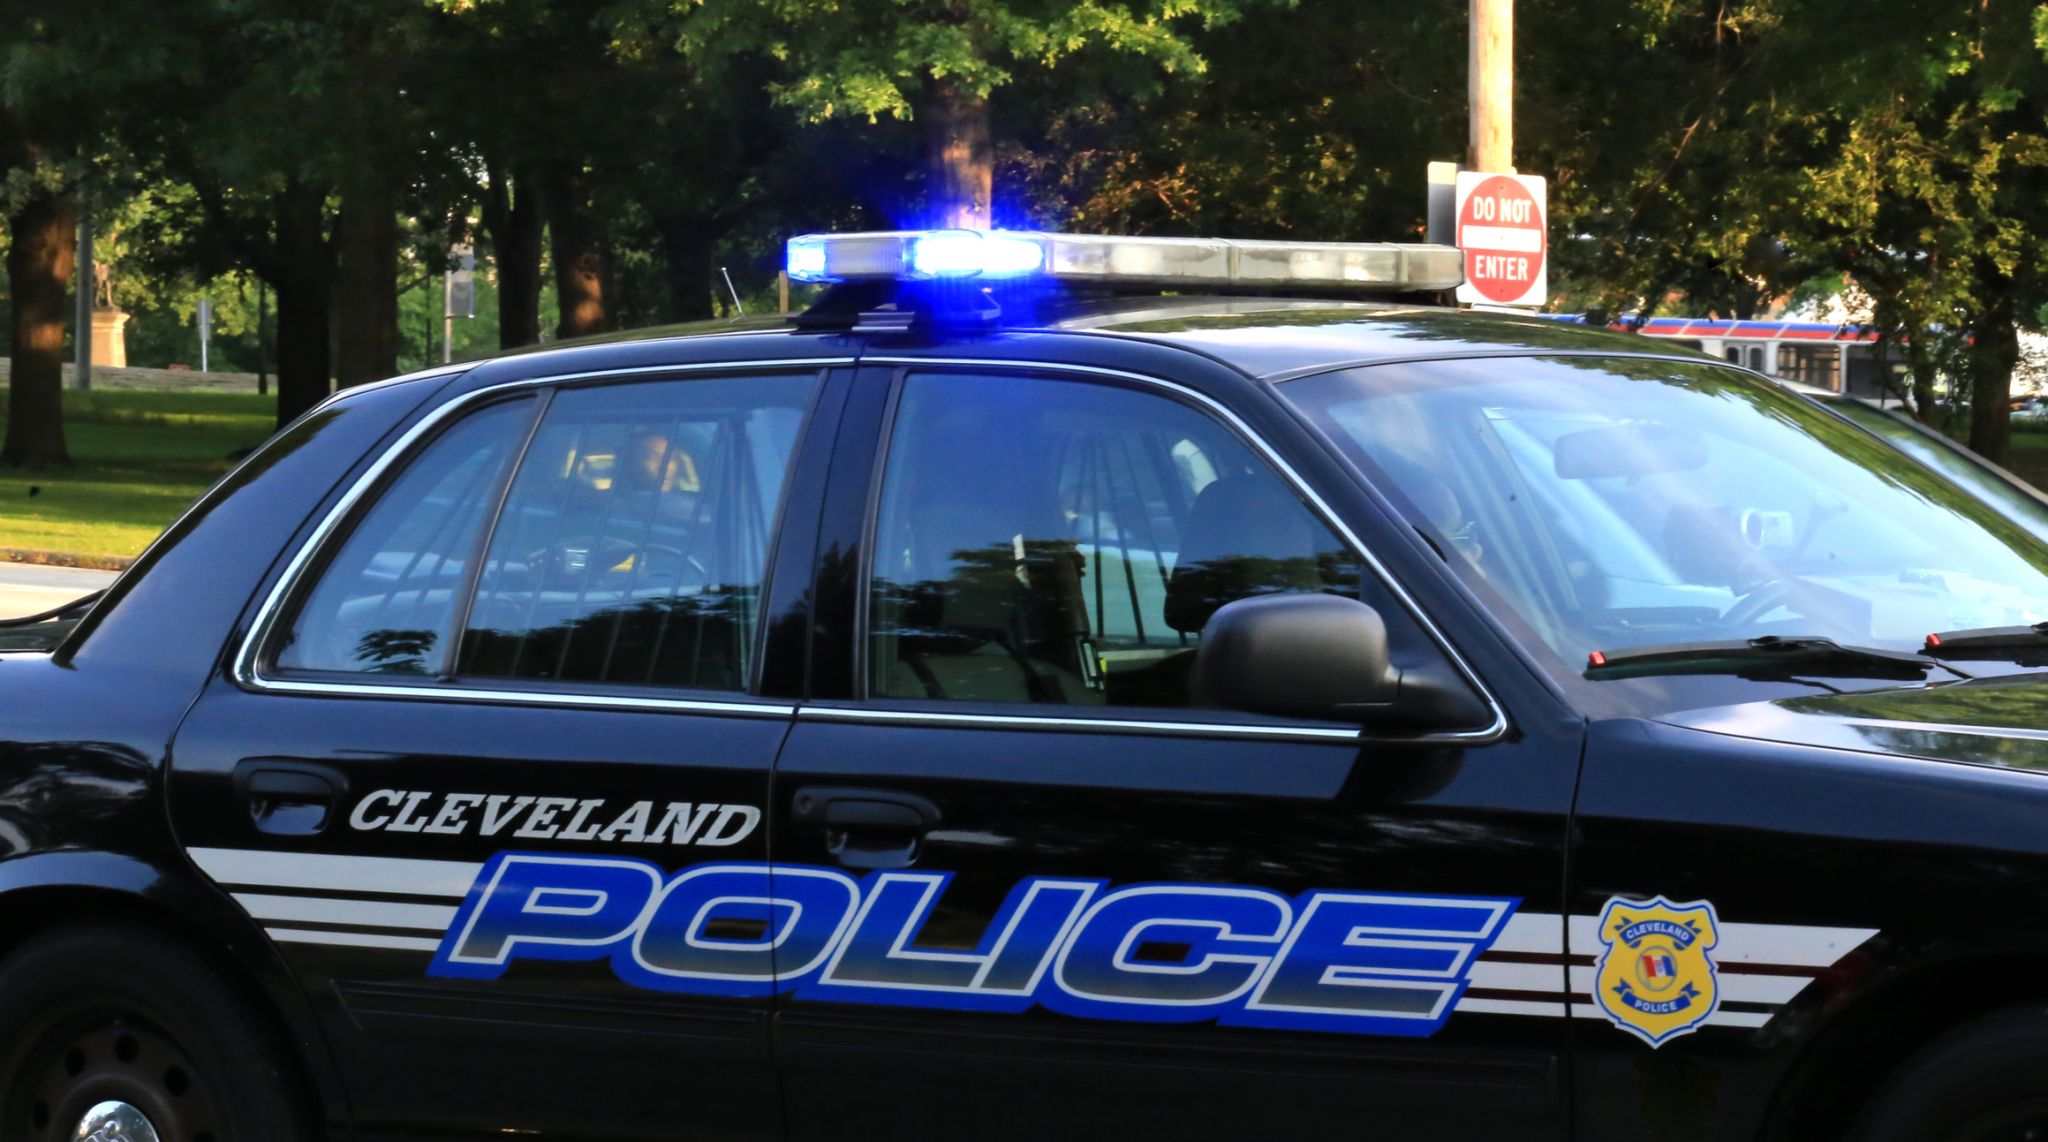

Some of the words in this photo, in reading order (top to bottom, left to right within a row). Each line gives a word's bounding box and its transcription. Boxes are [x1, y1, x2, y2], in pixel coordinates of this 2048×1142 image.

[1473, 196, 1495, 221] DO
[1500, 198, 1532, 224] NOT
[1475, 255, 1528, 281] ENTER
[349, 789, 761, 846] CLEVELAND
[428, 850, 1520, 1036] POLICE
[1625, 922, 1690, 942] CLEVELAND
[1634, 999, 1677, 1013] POLICE
